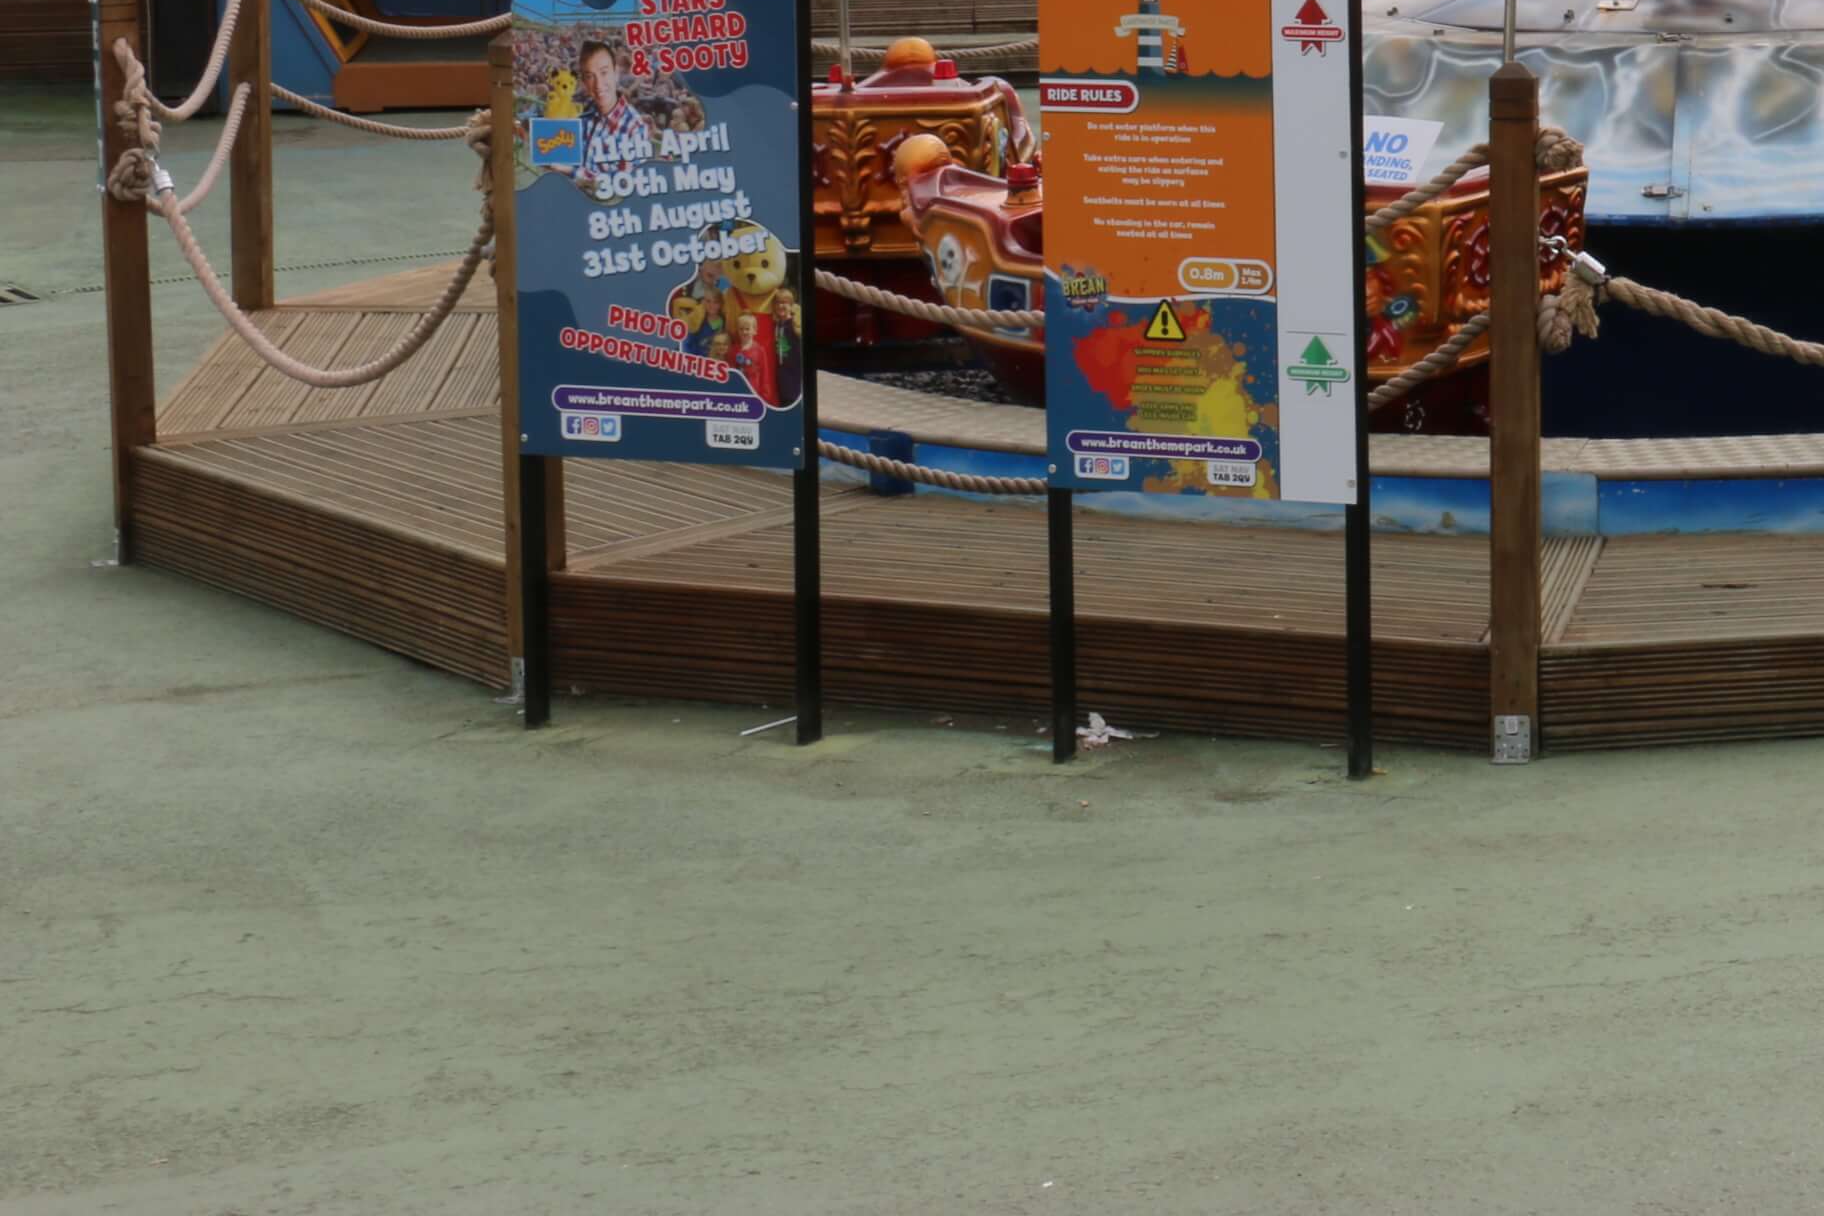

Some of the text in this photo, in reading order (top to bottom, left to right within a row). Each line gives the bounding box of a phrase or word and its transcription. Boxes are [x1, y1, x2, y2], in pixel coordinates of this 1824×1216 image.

[624, 12, 746, 47] RICHARD
[631, 40, 749, 77] & SOOTY
[1047, 88, 1123, 103] RIDE RULES
[592, 122, 731, 164] 11th April
[1365, 131, 1409, 154] NO
[594, 163, 737, 201] 30th May
[1367, 168, 1408, 181] SEATED
[588, 190, 753, 240] 8th August
[582, 230, 771, 279] 31st October
[1063, 276, 1105, 297] BREAN
[1189, 267, 1262, 281] 0.8m Max
[608, 305, 688, 341] PHOTO
[559, 328, 729, 384] OPPORTUNITIES
[567, 393, 750, 415] www.breanthemepark.co.uk
[1080, 436, 1247, 457] www.breanthemepark.co.uk
